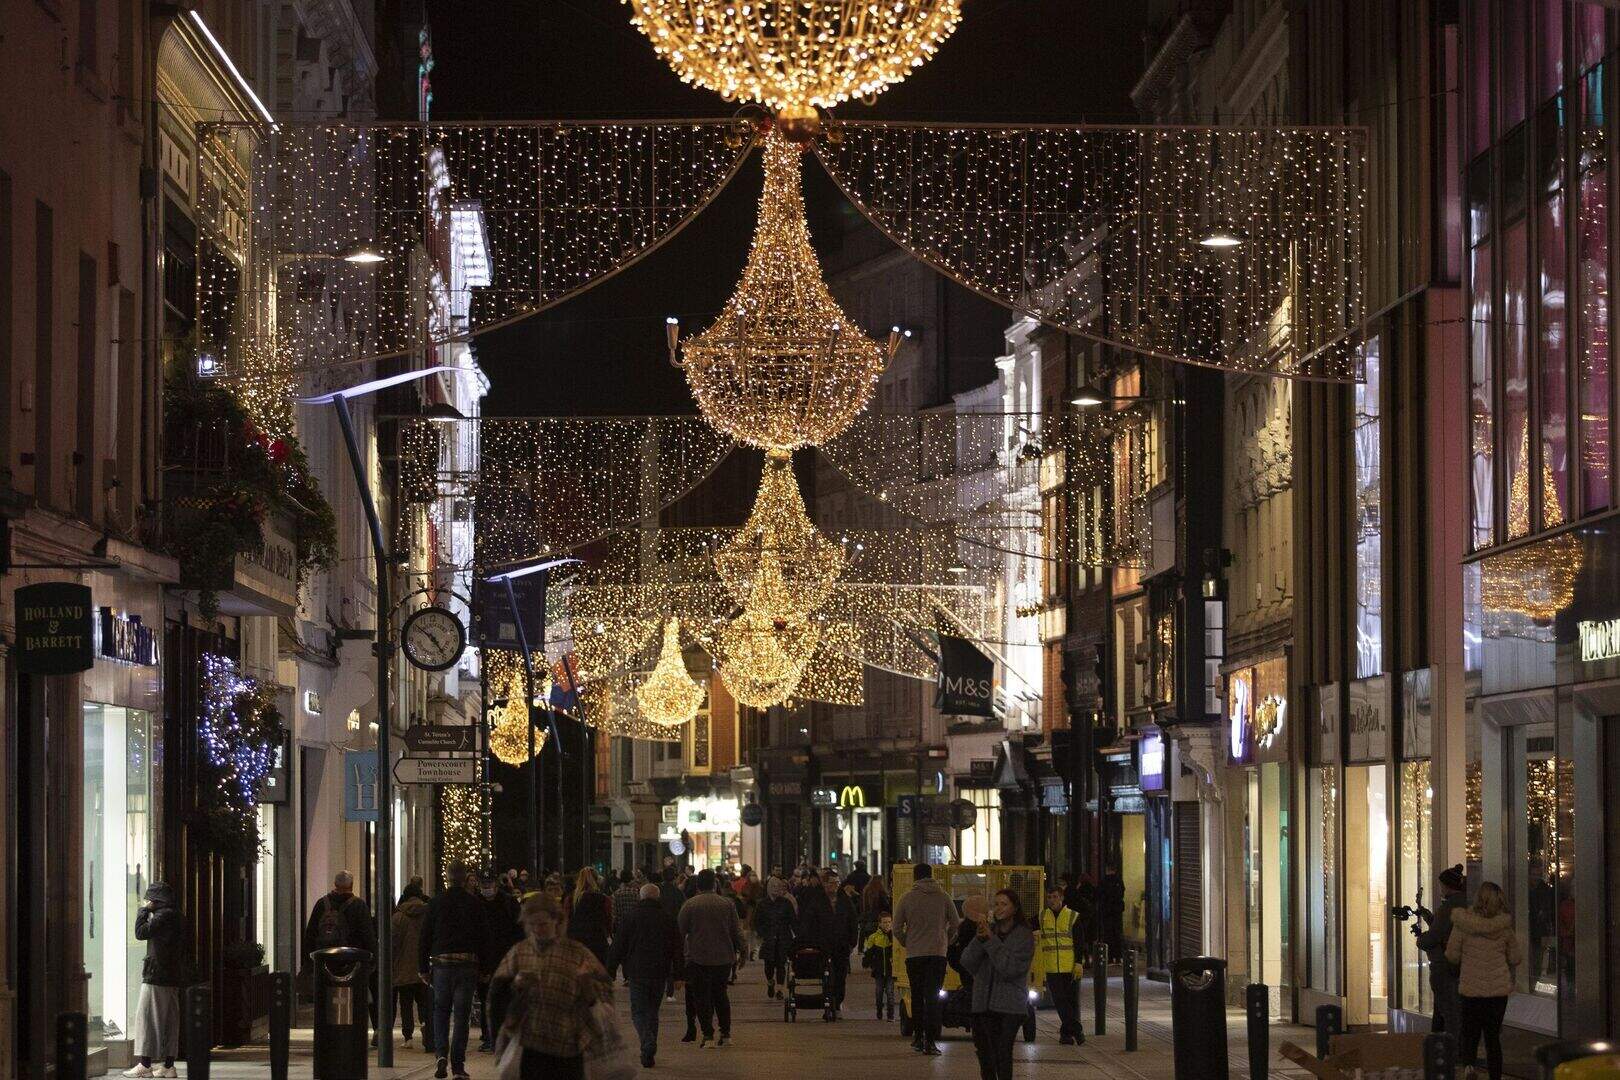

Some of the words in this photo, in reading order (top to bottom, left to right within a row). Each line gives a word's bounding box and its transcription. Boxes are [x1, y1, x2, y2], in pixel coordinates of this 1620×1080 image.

[24, 606, 83, 621] HOLLAND
[48, 619, 60, 634] &
[26, 636, 82, 651] BARRETT
[945, 676, 991, 699] M&S
[417, 760, 467, 768] Powerscourt
[418, 768, 462, 776] Townhouse
